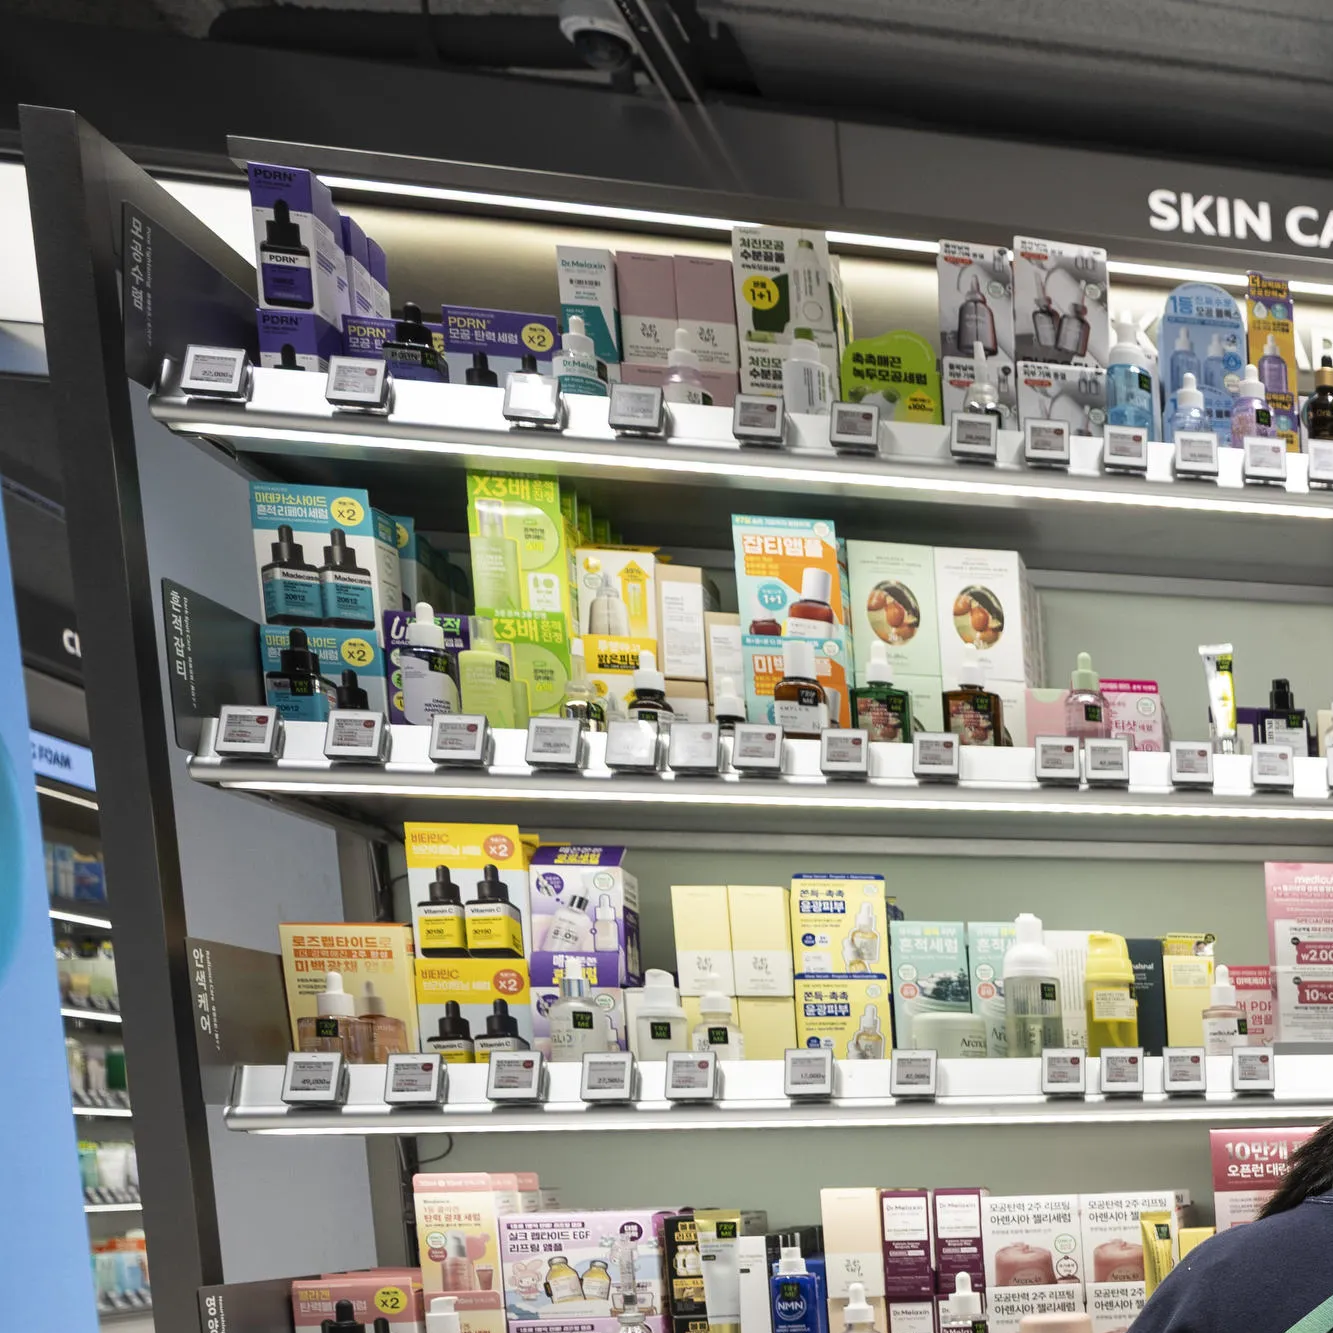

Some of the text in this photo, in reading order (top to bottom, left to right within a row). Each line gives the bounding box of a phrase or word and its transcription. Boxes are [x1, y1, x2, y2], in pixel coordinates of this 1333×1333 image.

[1147, 189, 1273, 242] SKIN
[655, 1030, 667, 1038] ME
[711, 1028, 727, 1036] TRY
[712, 1035, 725, 1043] ME
[1224, 1141, 1289, 1162] 10만개
[1227, 1164, 1265, 1178] 오픈런
[990, 1201, 1070, 1213] 모공탄력 2주 리프팅
[1088, 1198, 1168, 1210] 모공탄력 2주 리프팅
[990, 1214, 1030, 1225] 아렌시아
[1088, 1211, 1128, 1222] 아렌시아
[718, 1223, 735, 1231] TRY
[573, 1231, 590, 1240] EGF
[509, 1243, 540, 1253] 리프팅
[994, 1289, 1075, 1302] 모공탄력 2주 리프팅
[1094, 1287, 1145, 1298] 모공탄력 2주
[777, 1300, 804, 1312] NMN
[994, 1304, 1035, 1315] 아렌시아
[1094, 1300, 1134, 1310] 아렌시아
